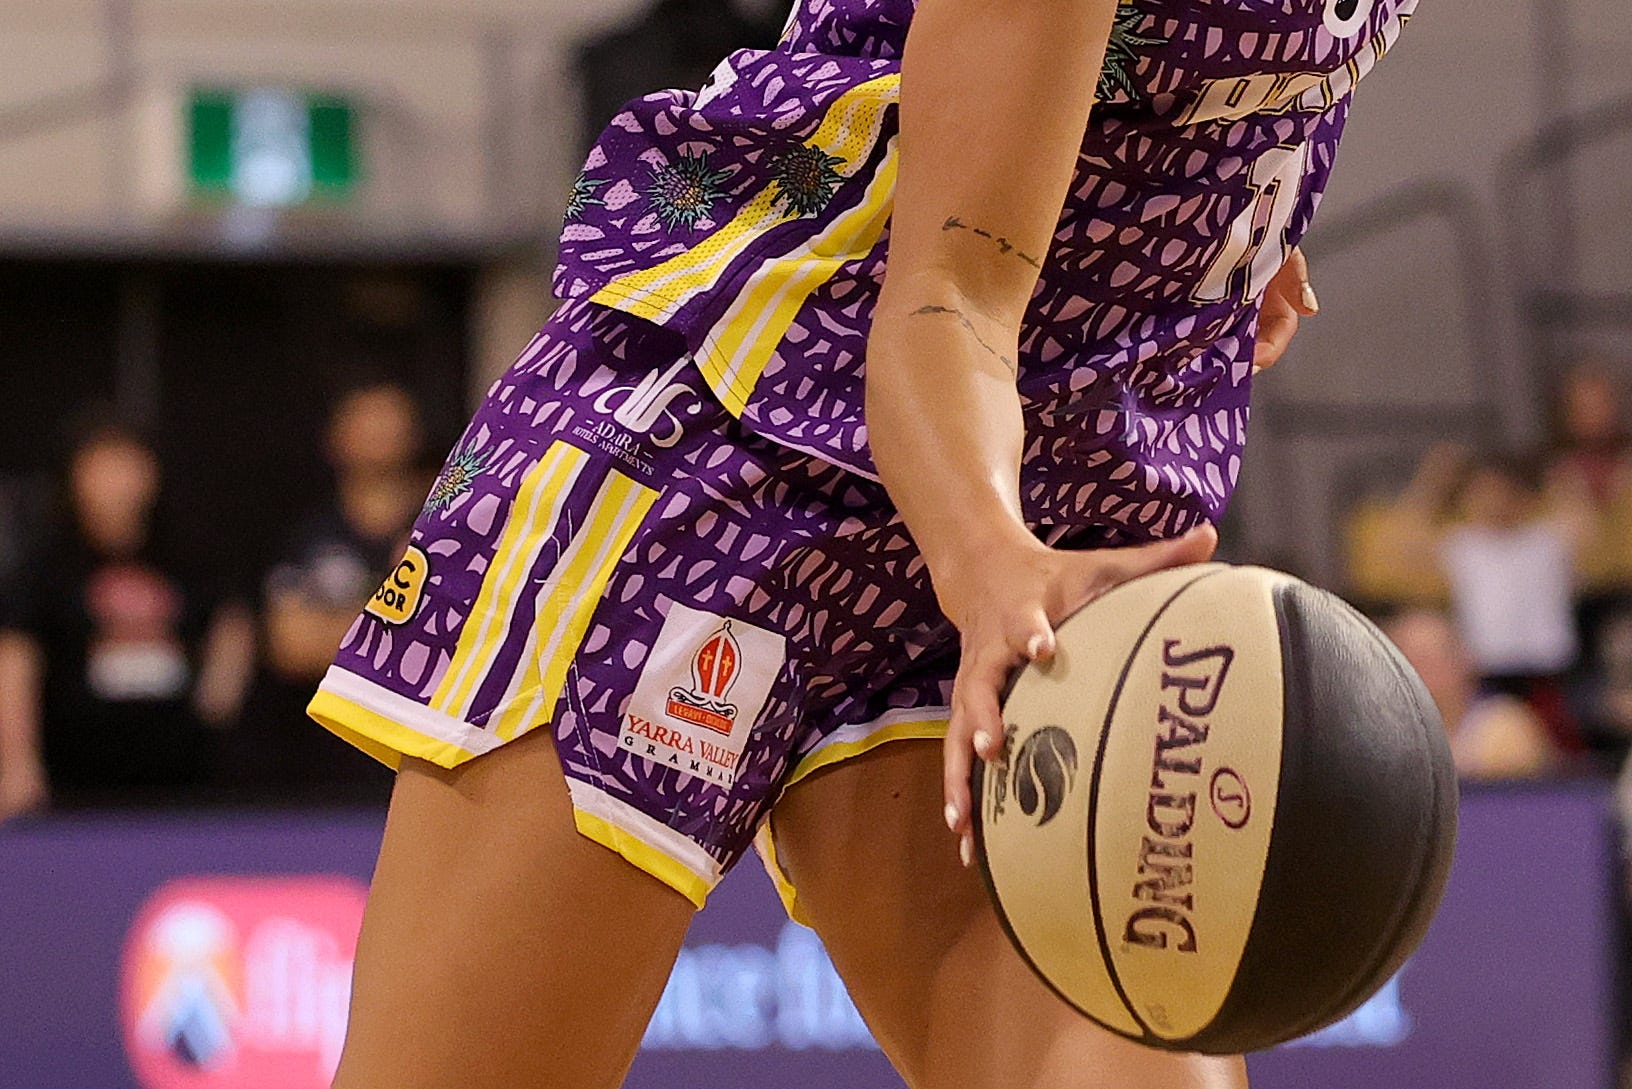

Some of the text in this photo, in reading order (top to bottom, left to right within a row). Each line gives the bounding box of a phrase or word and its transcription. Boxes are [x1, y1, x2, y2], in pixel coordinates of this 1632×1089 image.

[572, 425, 655, 476] HOTELS APARTMENTS
[592, 420, 640, 455] ADARA
[627, 713, 694, 754] YARRA
[700, 740, 739, 769] VALLEY
[1123, 638, 1235, 954] SPALDING
